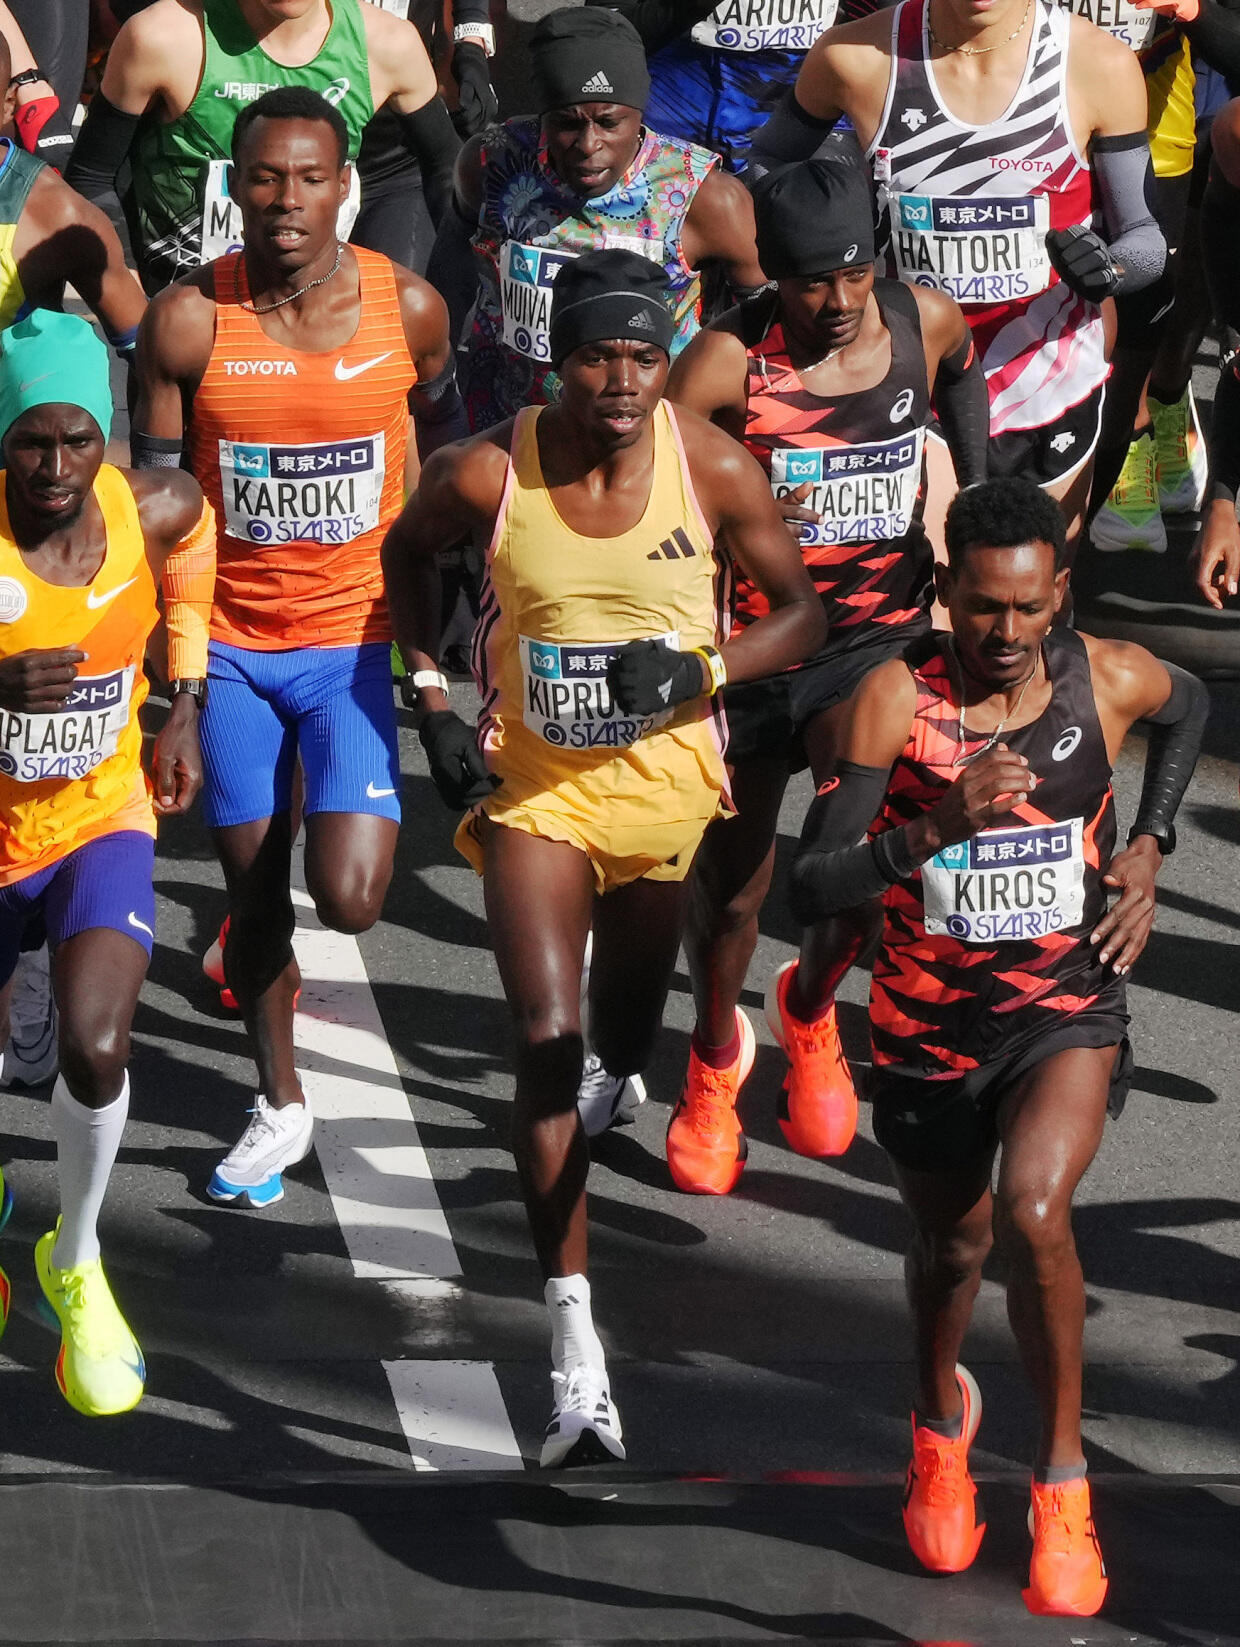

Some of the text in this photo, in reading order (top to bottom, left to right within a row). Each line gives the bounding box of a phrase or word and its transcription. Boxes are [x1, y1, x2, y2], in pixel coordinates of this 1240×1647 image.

[581, 85, 614, 94] adidas
[988, 157, 1053, 172] TOYOTA
[939, 205, 1028, 224] 東京メトロ
[898, 231, 1021, 274] HATTORI
[223, 361, 298, 376] TOYOTA
[277, 448, 368, 472] 東京メトロ
[828, 445, 912, 472] 東京メトロ
[233, 478, 355, 518] KAROKI
[776, 473, 904, 518] TACHEW
[275, 514, 365, 542] STARTS
[822, 513, 906, 544] STARTS
[567, 654, 621, 671] 東京
[64, 682, 118, 704] メトロ
[527, 675, 630, 721] KIPRU
[976, 835, 1067, 861] 東京メトロ
[954, 868, 1057, 912] KIROS
[975, 907, 1063, 939] STARTS
